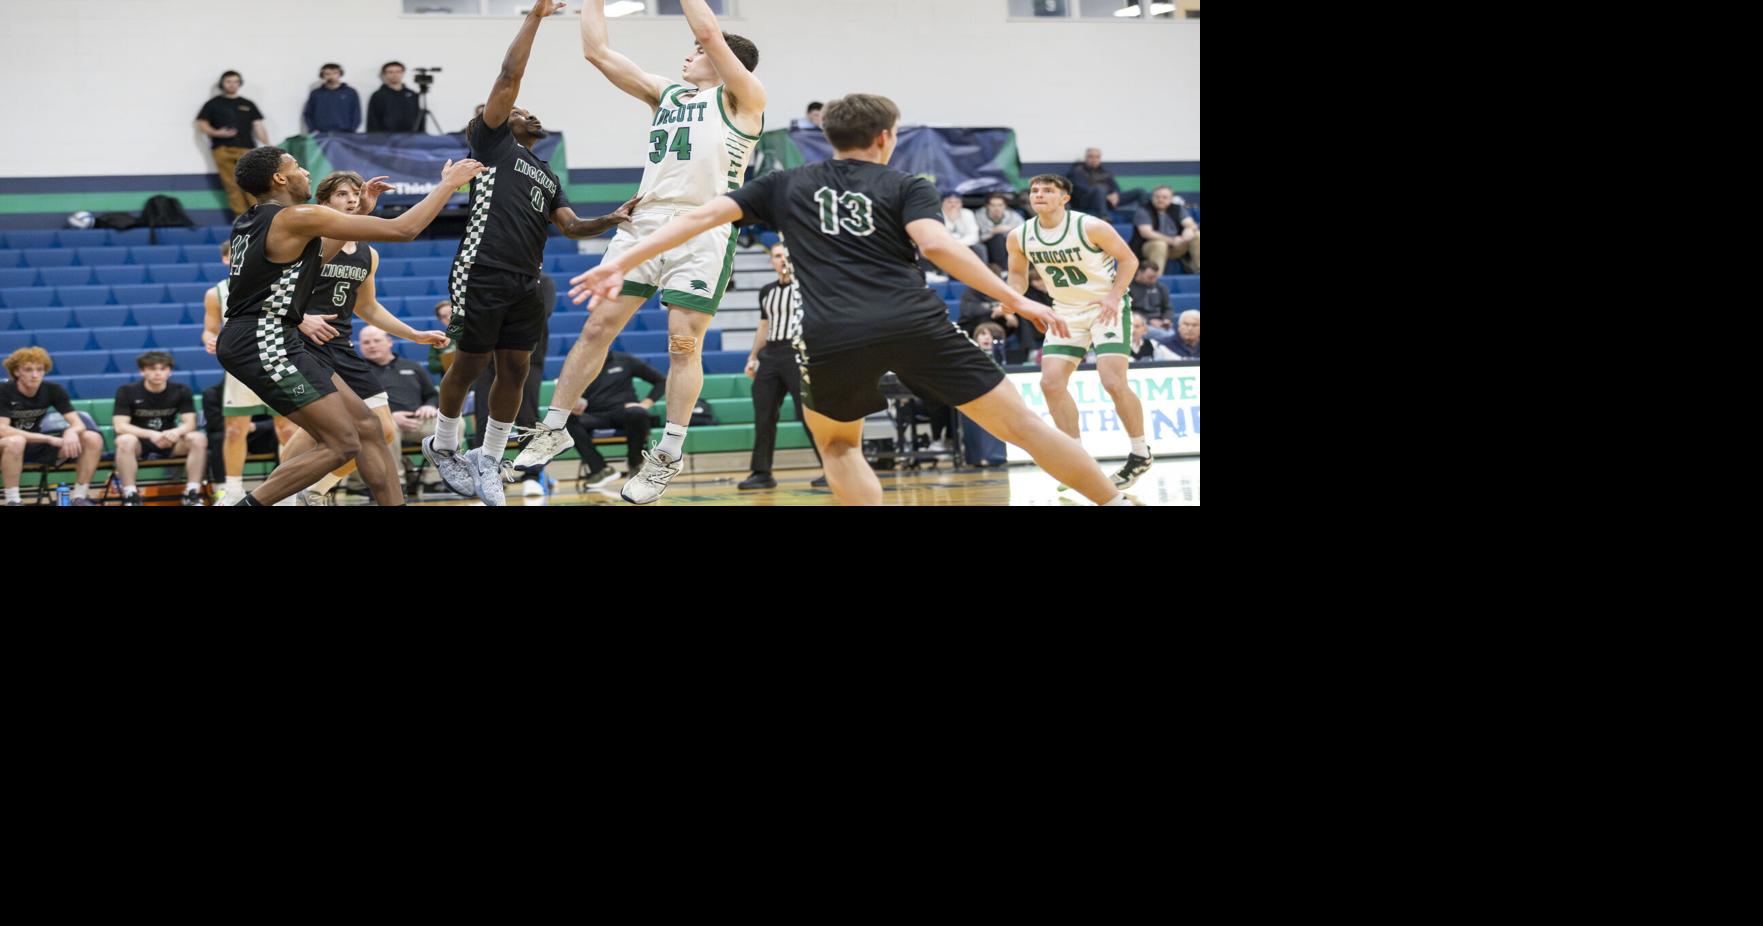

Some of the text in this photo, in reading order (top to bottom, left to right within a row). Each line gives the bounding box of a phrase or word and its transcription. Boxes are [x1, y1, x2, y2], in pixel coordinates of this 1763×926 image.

[648, 126, 692, 164] 34
[813, 185, 877, 236] 13
[1028, 246, 1083, 264] ENDICOTT
[320, 263, 368, 281] NICHOLS
[1045, 265, 1089, 287] 20
[332, 281, 351, 306] 5
[1079, 409, 1122, 433] TH
